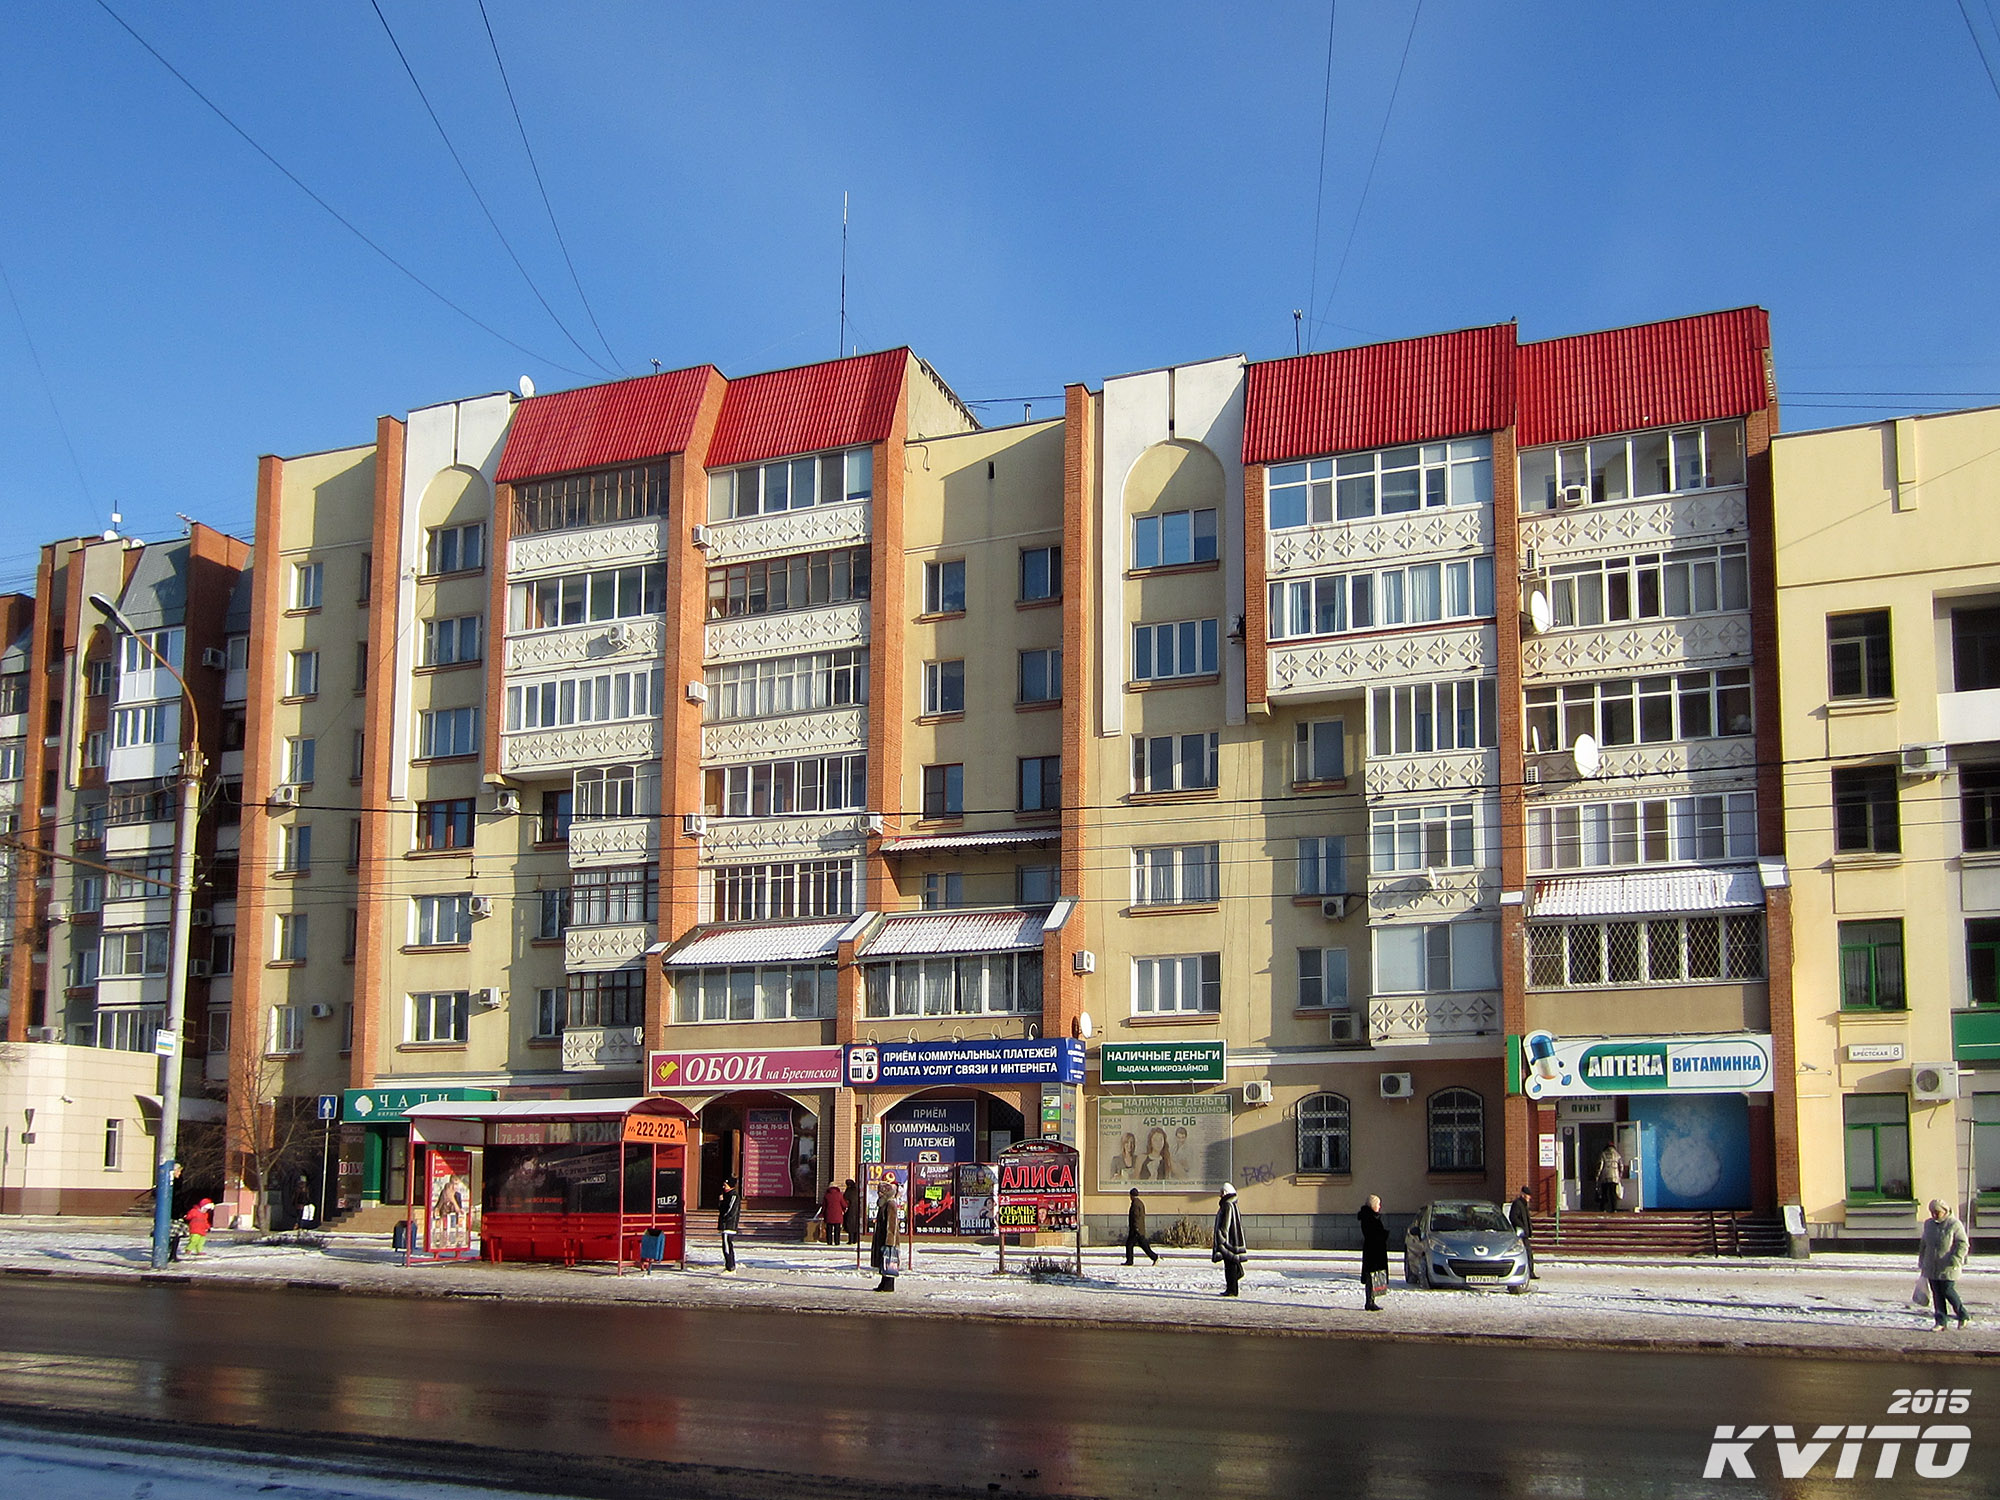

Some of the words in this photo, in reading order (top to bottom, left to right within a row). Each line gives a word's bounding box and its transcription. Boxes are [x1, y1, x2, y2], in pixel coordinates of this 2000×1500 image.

[883, 1048, 917, 1062] ПРИЁМ
[918, 1049, 1001, 1061] КОММУНАЛЬНЫХ
[1003, 1045, 1058, 1059] ПЛАТЕЖЕЙ
[1107, 1051, 1171, 1061] НАЛИЧНЫЕ
[1173, 1050, 1220, 1062] ДЕНЬГИ
[1893, 1047, 1900, 1056] 8
[685, 1055, 768, 1082] ОБОИ
[766, 1072, 779, 1080] на
[781, 1067, 839, 1083] Брестской
[883, 1065, 921, 1077] ОПЛАТА
[922, 1064, 953, 1076] УСЛУГ
[955, 1063, 989, 1075] СВЯЗИ
[991, 1064, 998, 1074] И
[1000, 1062, 1058, 1074] ИНТЕРНЕТА
[1117, 1065, 1149, 1073] ВЫДАЧА
[1150, 1063, 1209, 1072] МИКРОЗАЙМОВ
[1587, 1055, 1664, 1077] АПТЕКА
[1672, 1055, 1762, 1073] ВИТАМИНКА
[1124, 1097, 1184, 1107] НАЛИЧНЫЕ
[1185, 1097, 1227, 1107] ДЕНЬГИ
[913, 1107, 947, 1119] ПРИЁМ
[1571, 1104, 1601, 1113] ПУНКТ
[1143, 1116, 1196, 1127] 49-06-06
[889, 1123, 971, 1133] КОММУНАЛЬНЫХ
[903, 1135, 956, 1147] ПЛАТЕЖЕЙ
[869, 1165, 883, 1180] 19
[920, 1166, 926, 1178] 4
[1001, 1165, 1074, 1188] АЛИСА
[657, 1195, 678, 1205] TELE2
[961, 1197, 969, 1205] 15
[1000, 1195, 1010, 1203] 23
[1000, 1205, 1037, 1215] СОБАЧЬЕ
[960, 1219, 991, 1228] ВАЕНГА
[1000, 1215, 1037, 1225] СЕРДЦЕ
